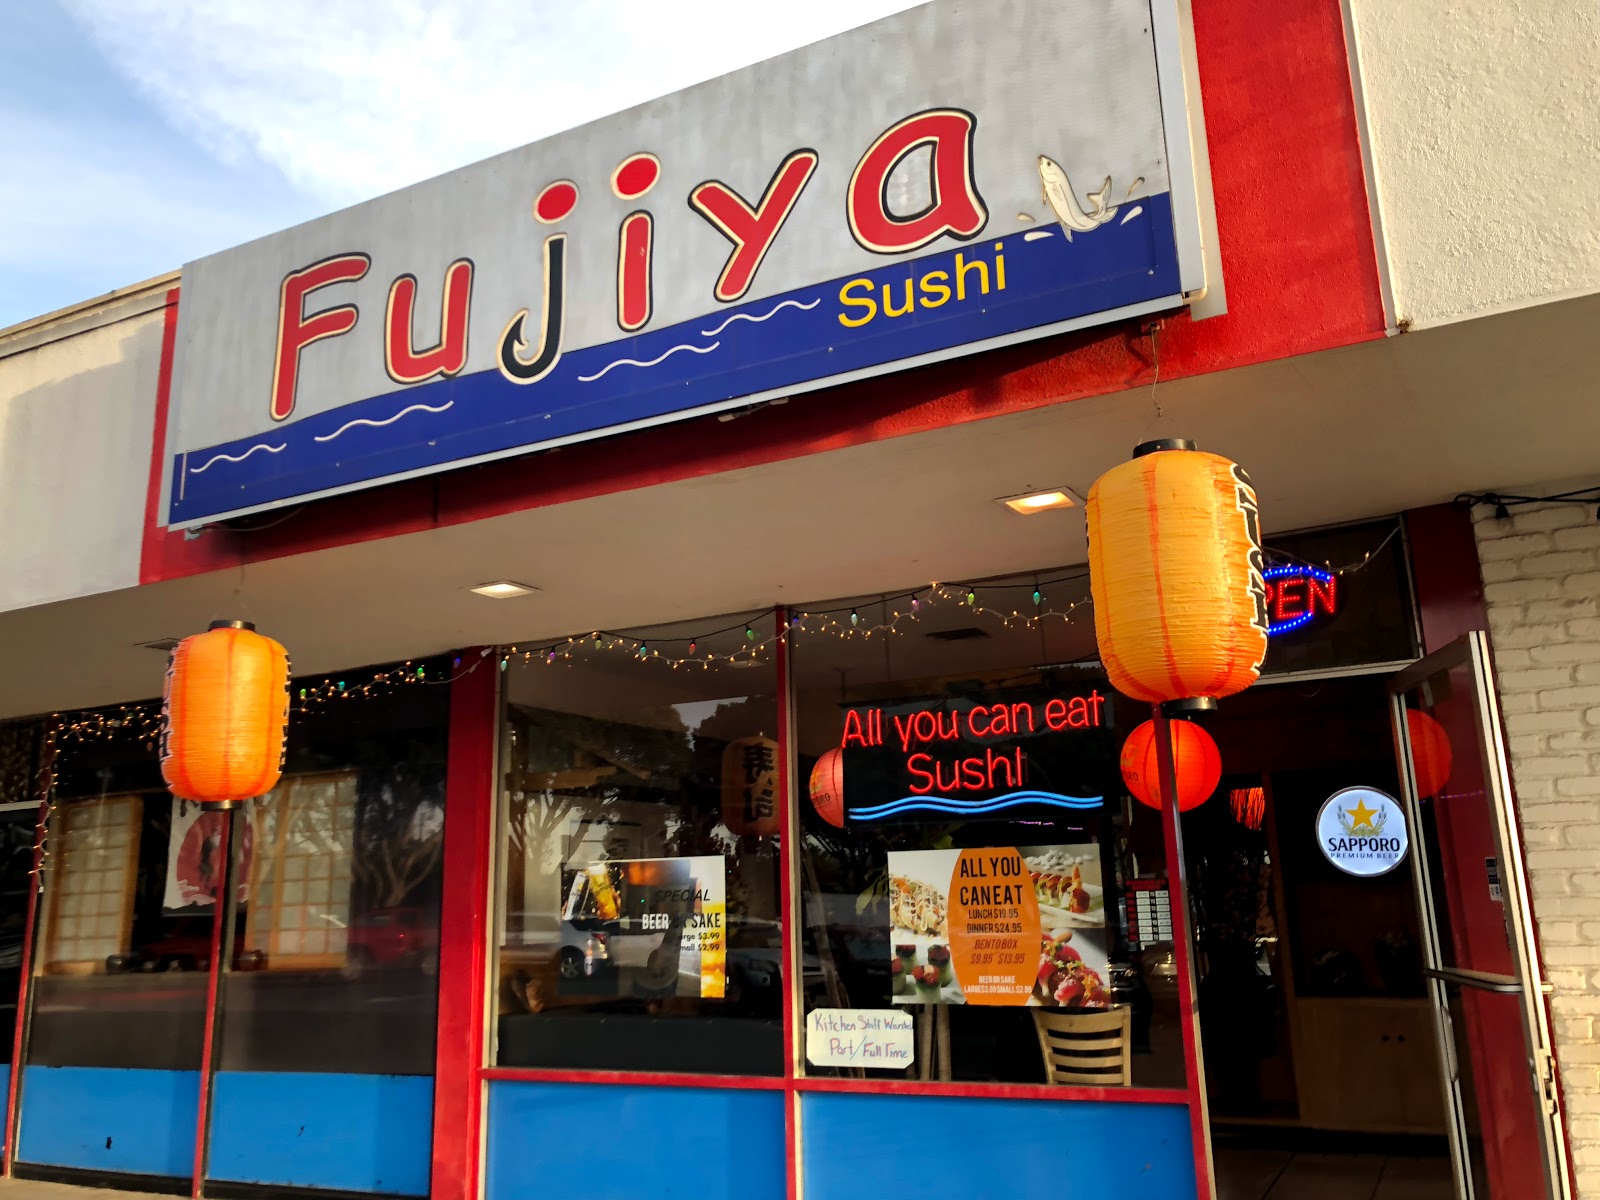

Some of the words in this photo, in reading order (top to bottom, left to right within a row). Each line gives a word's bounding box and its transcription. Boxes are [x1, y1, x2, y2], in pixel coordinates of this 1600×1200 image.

[270, 107, 989, 422] Fujiya
[838, 241, 1007, 328] Sushi
[842, 708, 883, 749] All
[894, 709, 959, 752] you
[968, 702, 1035, 737] can
[1045, 689, 1105, 731] eat
[1328, 837, 1400, 852] SAPPORO
[960, 857, 987, 878] ALL
[989, 856, 1021, 877] YOU
[655, 888, 711, 903] SPECIAL
[641, 912, 669, 930] BEER
[691, 912, 721, 929] SAKE
[698, 932, 720, 940] $3.99
[698, 943, 720, 951] $2.99
[814, 1013, 857, 1032] Kitchen
[884, 1042, 909, 1059] Time
